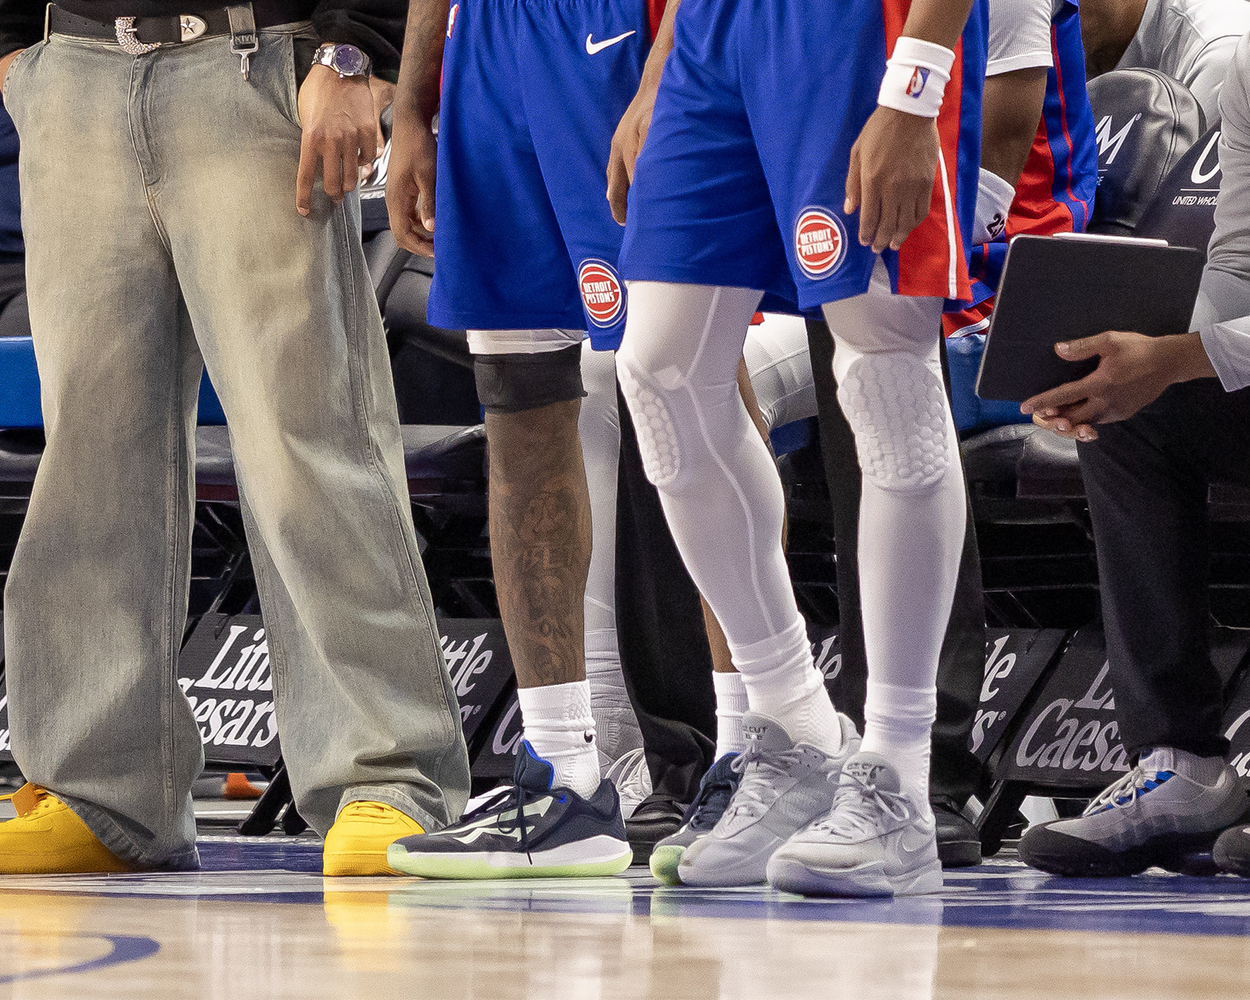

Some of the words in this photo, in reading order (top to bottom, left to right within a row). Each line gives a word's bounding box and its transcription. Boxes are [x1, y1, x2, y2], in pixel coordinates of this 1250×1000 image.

[1172, 195, 1198, 206] UNITED
[800, 228, 832, 245] DETROIT
[801, 240, 835, 257] PISTONS
[582, 280, 612, 293] DETROIT
[585, 291, 616, 304] PISTONS
[194, 625, 273, 691] Litt
[178, 678, 279, 748] esars
[1016, 698, 1131, 772] Caesa
